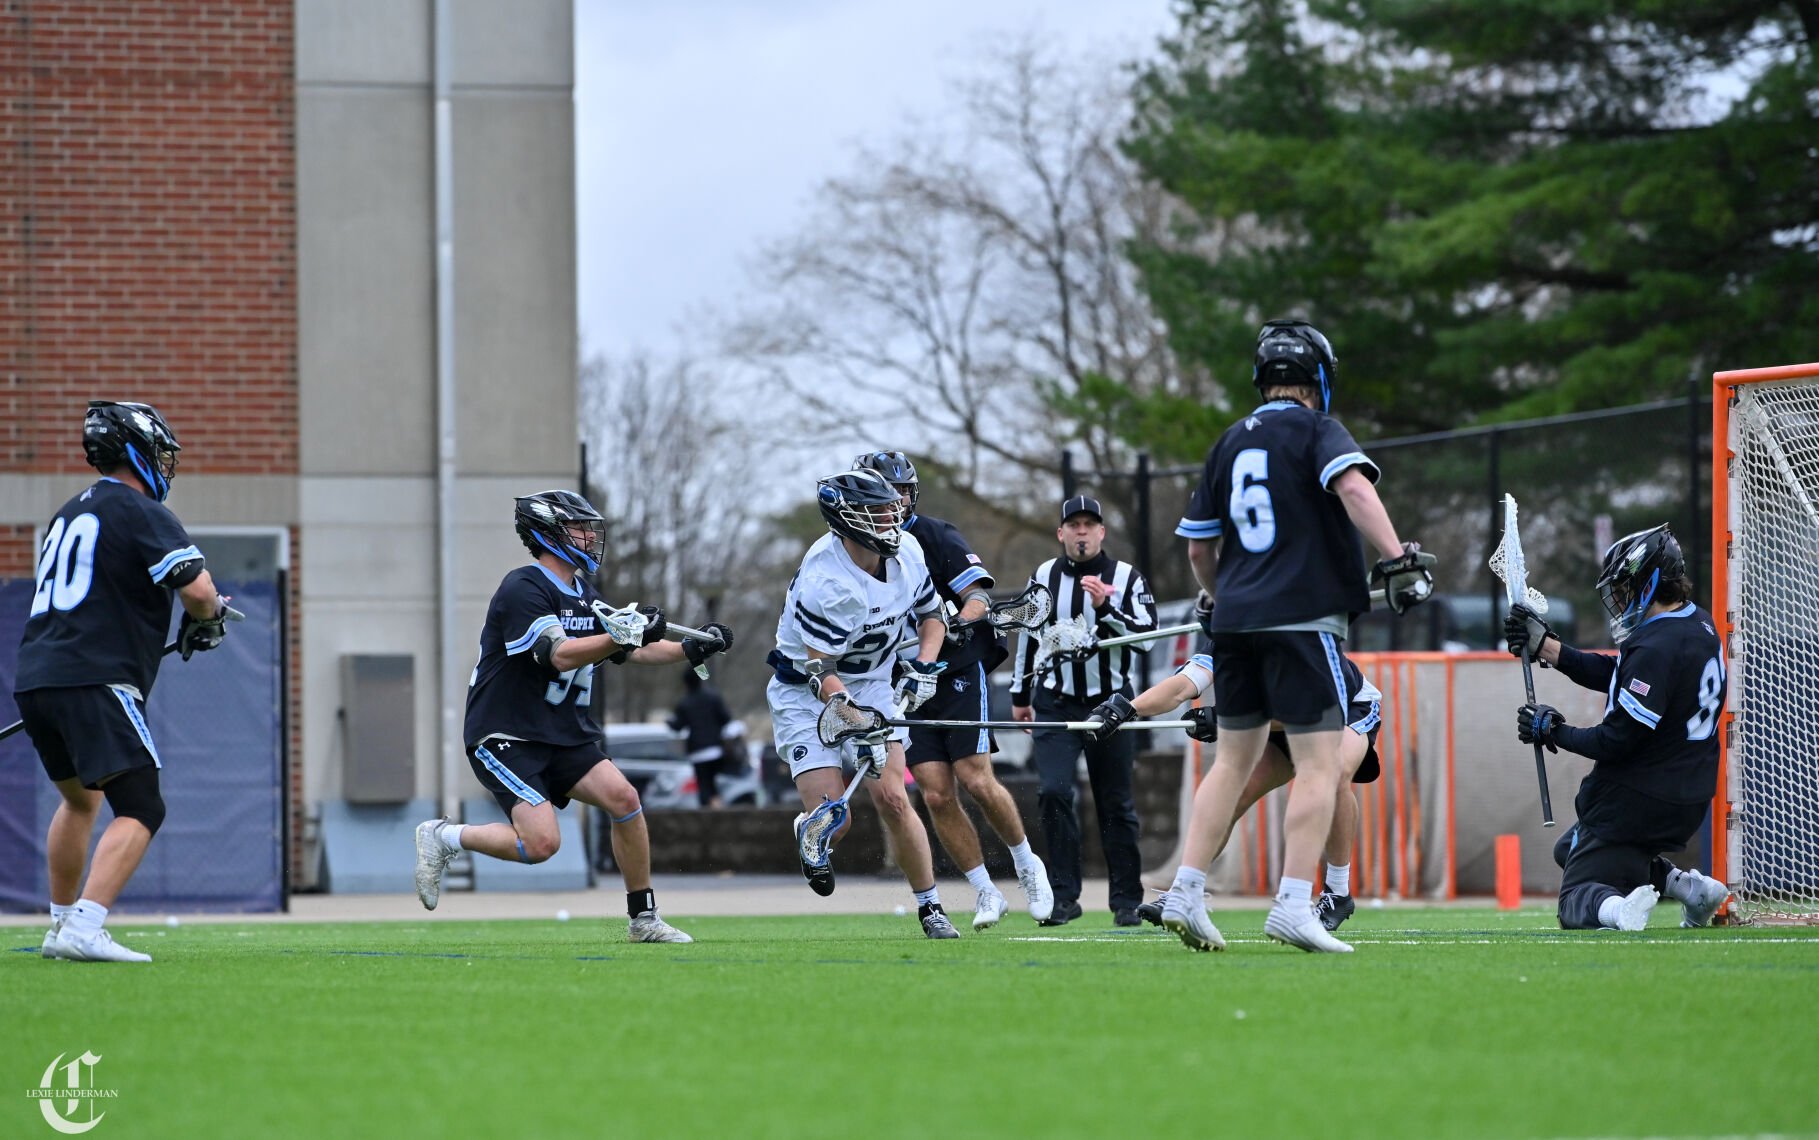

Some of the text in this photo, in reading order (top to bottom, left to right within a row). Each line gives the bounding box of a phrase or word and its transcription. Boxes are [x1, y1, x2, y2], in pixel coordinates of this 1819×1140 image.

[1230, 448, 1276, 553] 6
[30, 512, 100, 618] 20
[1686, 650, 1727, 741] 8
